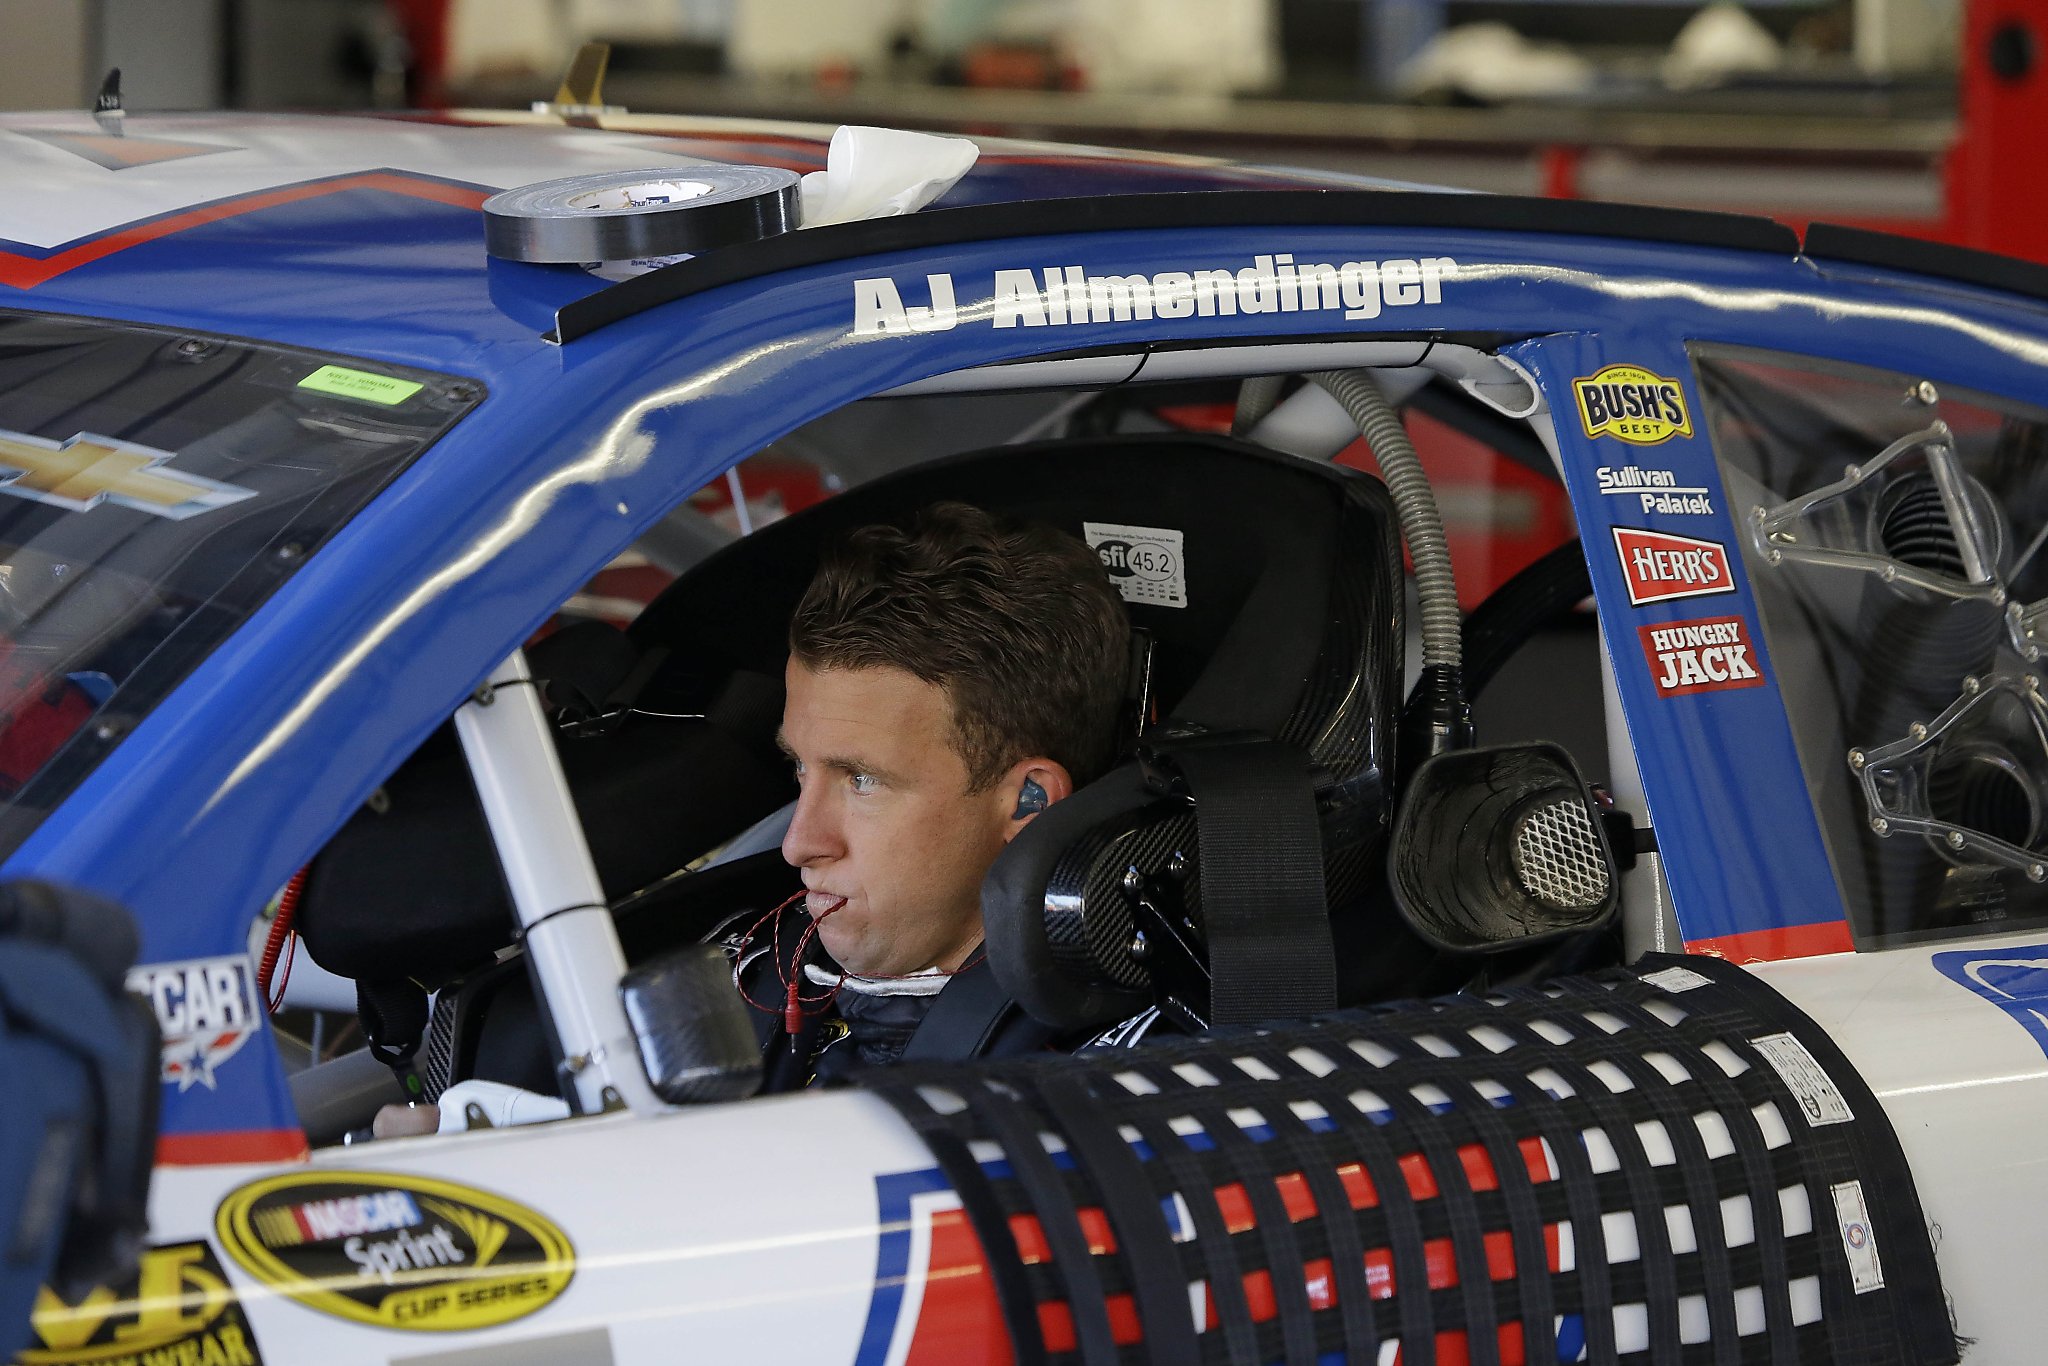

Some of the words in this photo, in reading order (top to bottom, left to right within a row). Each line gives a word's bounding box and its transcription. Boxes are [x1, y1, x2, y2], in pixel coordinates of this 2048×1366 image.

[853, 273, 958, 336] AJ
[992, 253, 1459, 330] Allmendinger
[1581, 383, 1685, 427] BUSH'S
[1619, 423, 1661, 435] BEST
[1596, 466, 1676, 488] Sullivan
[1640, 493, 1714, 515] Palatek
[1132, 550, 1170, 574] 45.2
[1632, 547, 1720, 584] HERR'S
[1650, 622, 1741, 652] HUNGRY
[1658, 644, 1757, 688] JACK
[301, 1189, 417, 1240] NASCAR
[344, 1223, 466, 1286] Sprint
[393, 1295, 449, 1322] CUP
[457, 1276, 549, 1311] SERIES
